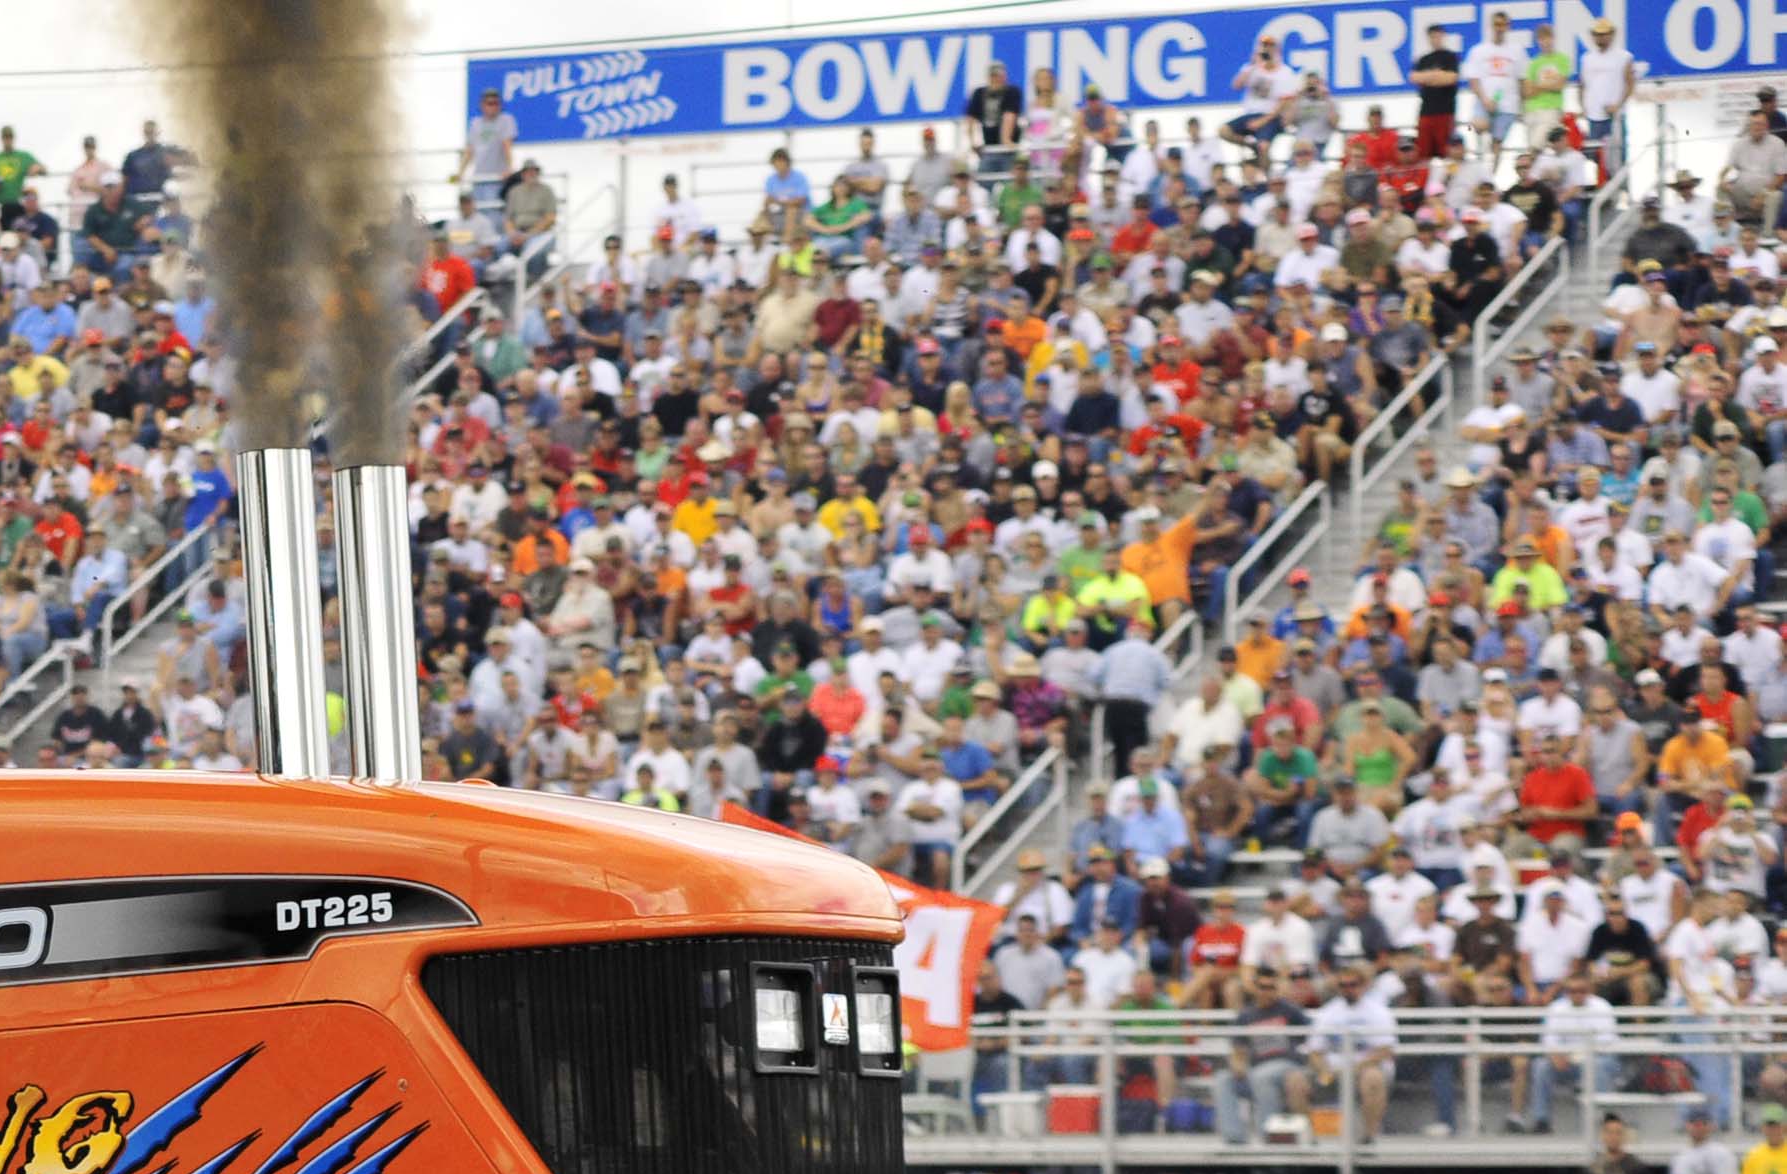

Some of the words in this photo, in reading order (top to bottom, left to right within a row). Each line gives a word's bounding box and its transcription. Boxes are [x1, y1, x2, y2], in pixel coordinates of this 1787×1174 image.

[503, 61, 573, 102] PULL
[556, 71, 663, 118] TOWN
[276, 892, 394, 931] DT225
